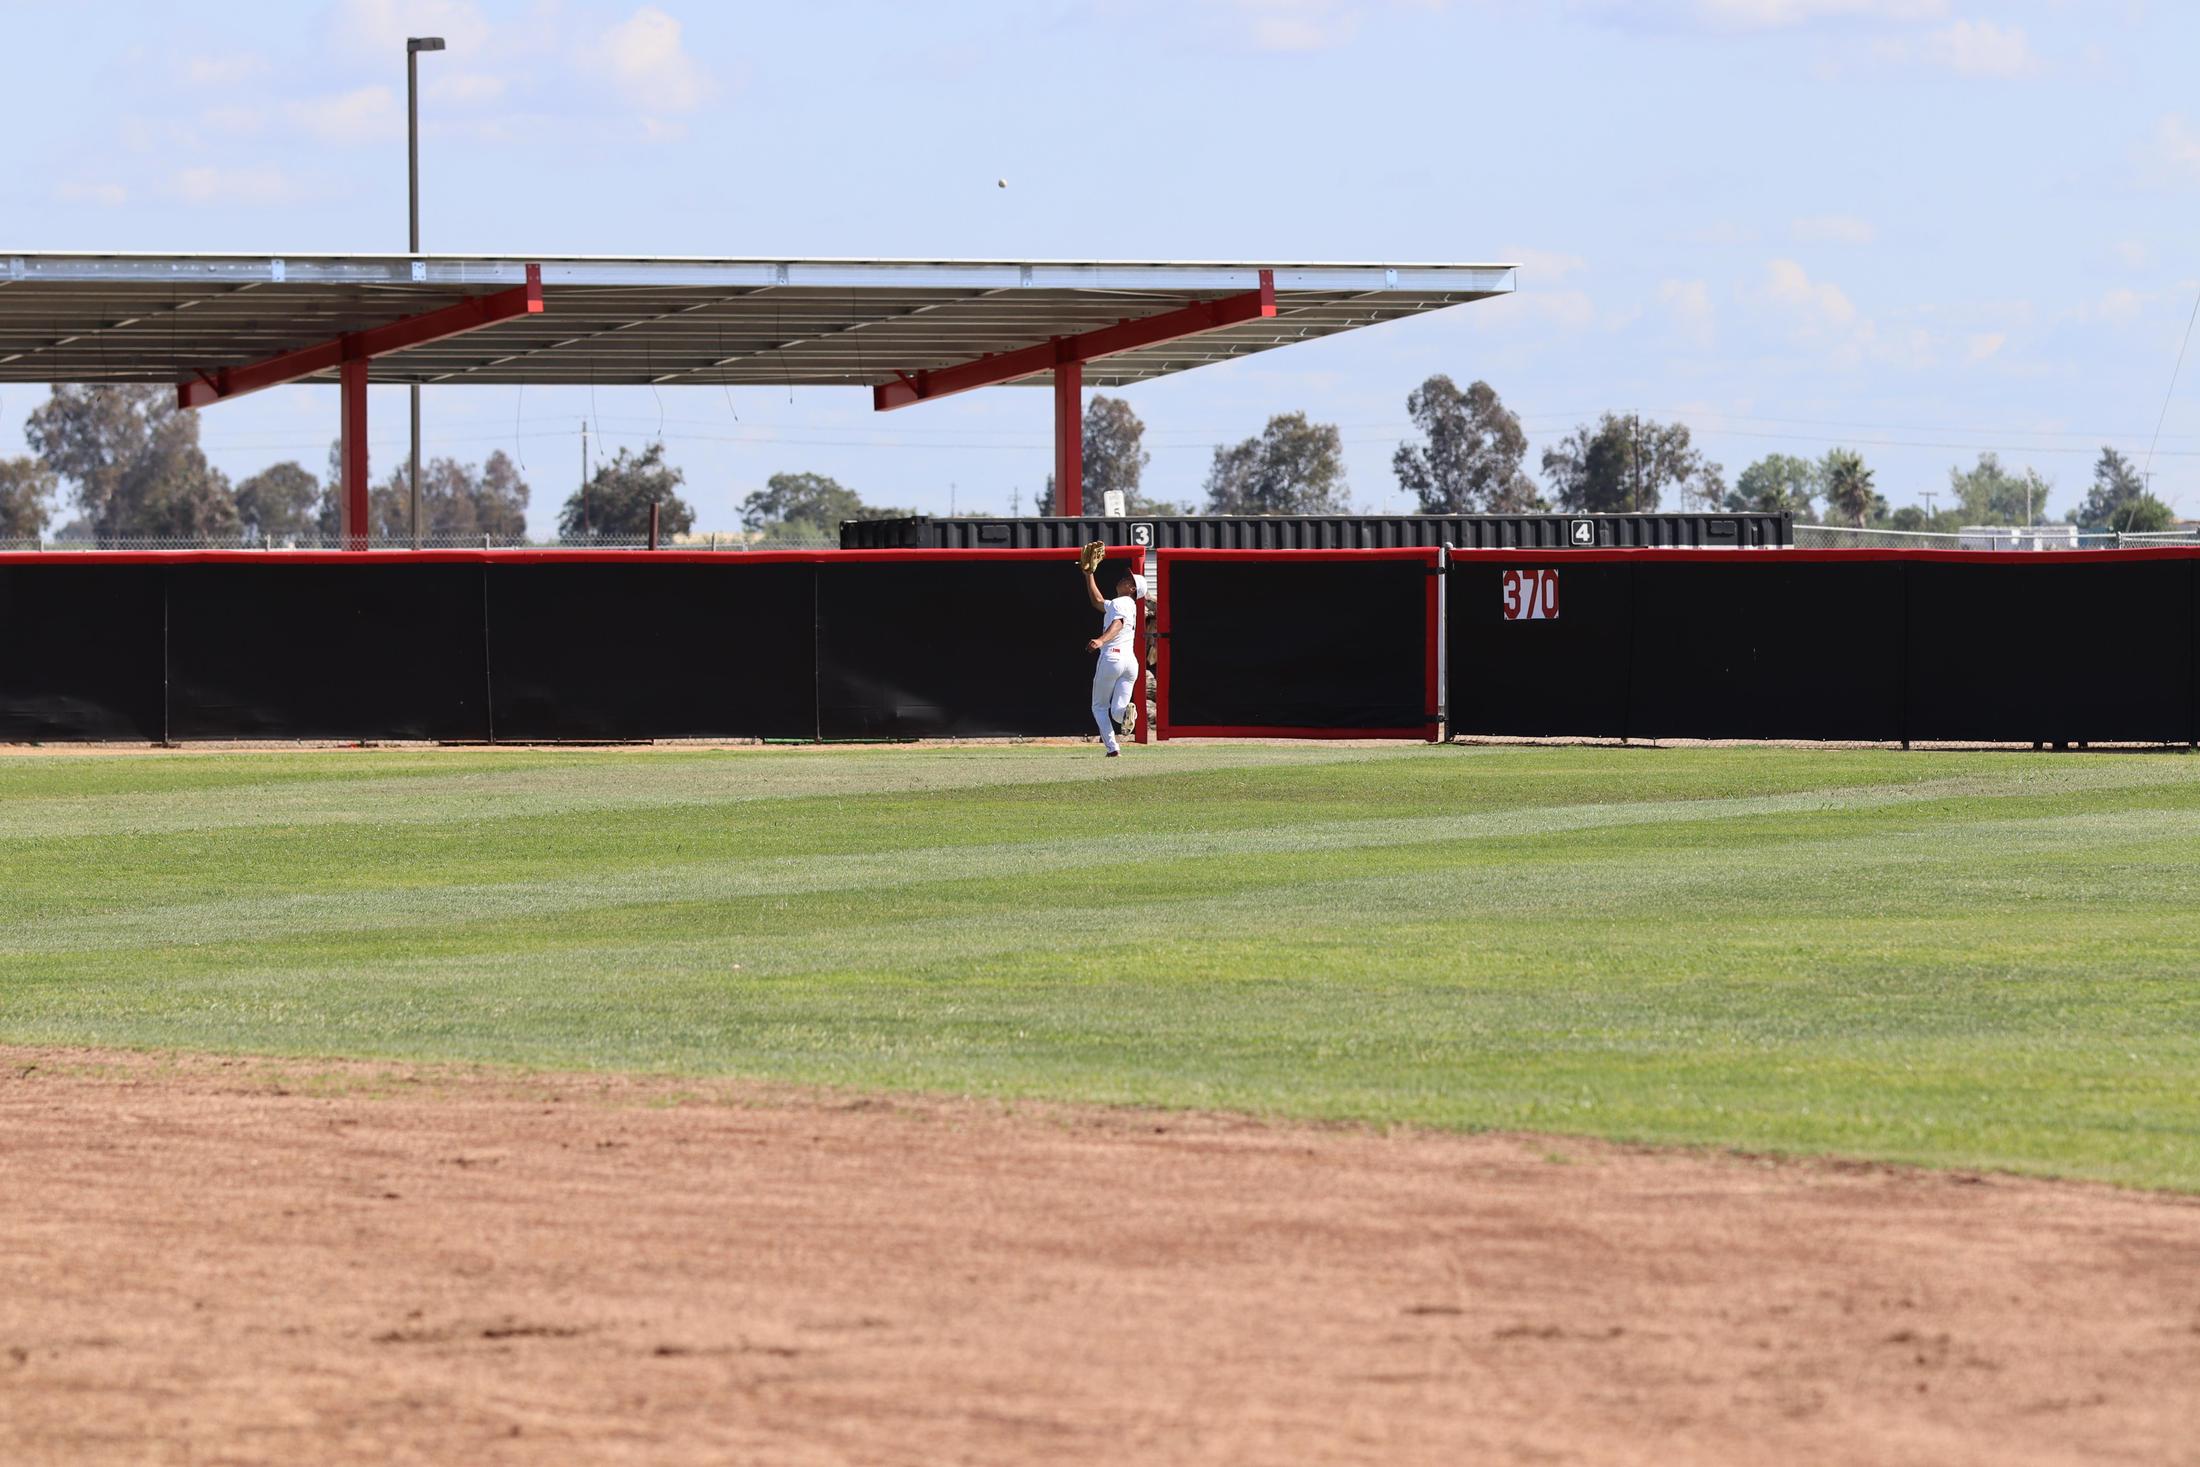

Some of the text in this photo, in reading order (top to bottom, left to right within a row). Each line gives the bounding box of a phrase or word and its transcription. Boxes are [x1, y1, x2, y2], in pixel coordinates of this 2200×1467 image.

[1135, 526, 1149, 545] 3
[1575, 523, 1590, 542] 4
[1503, 570, 1559, 620] 370
